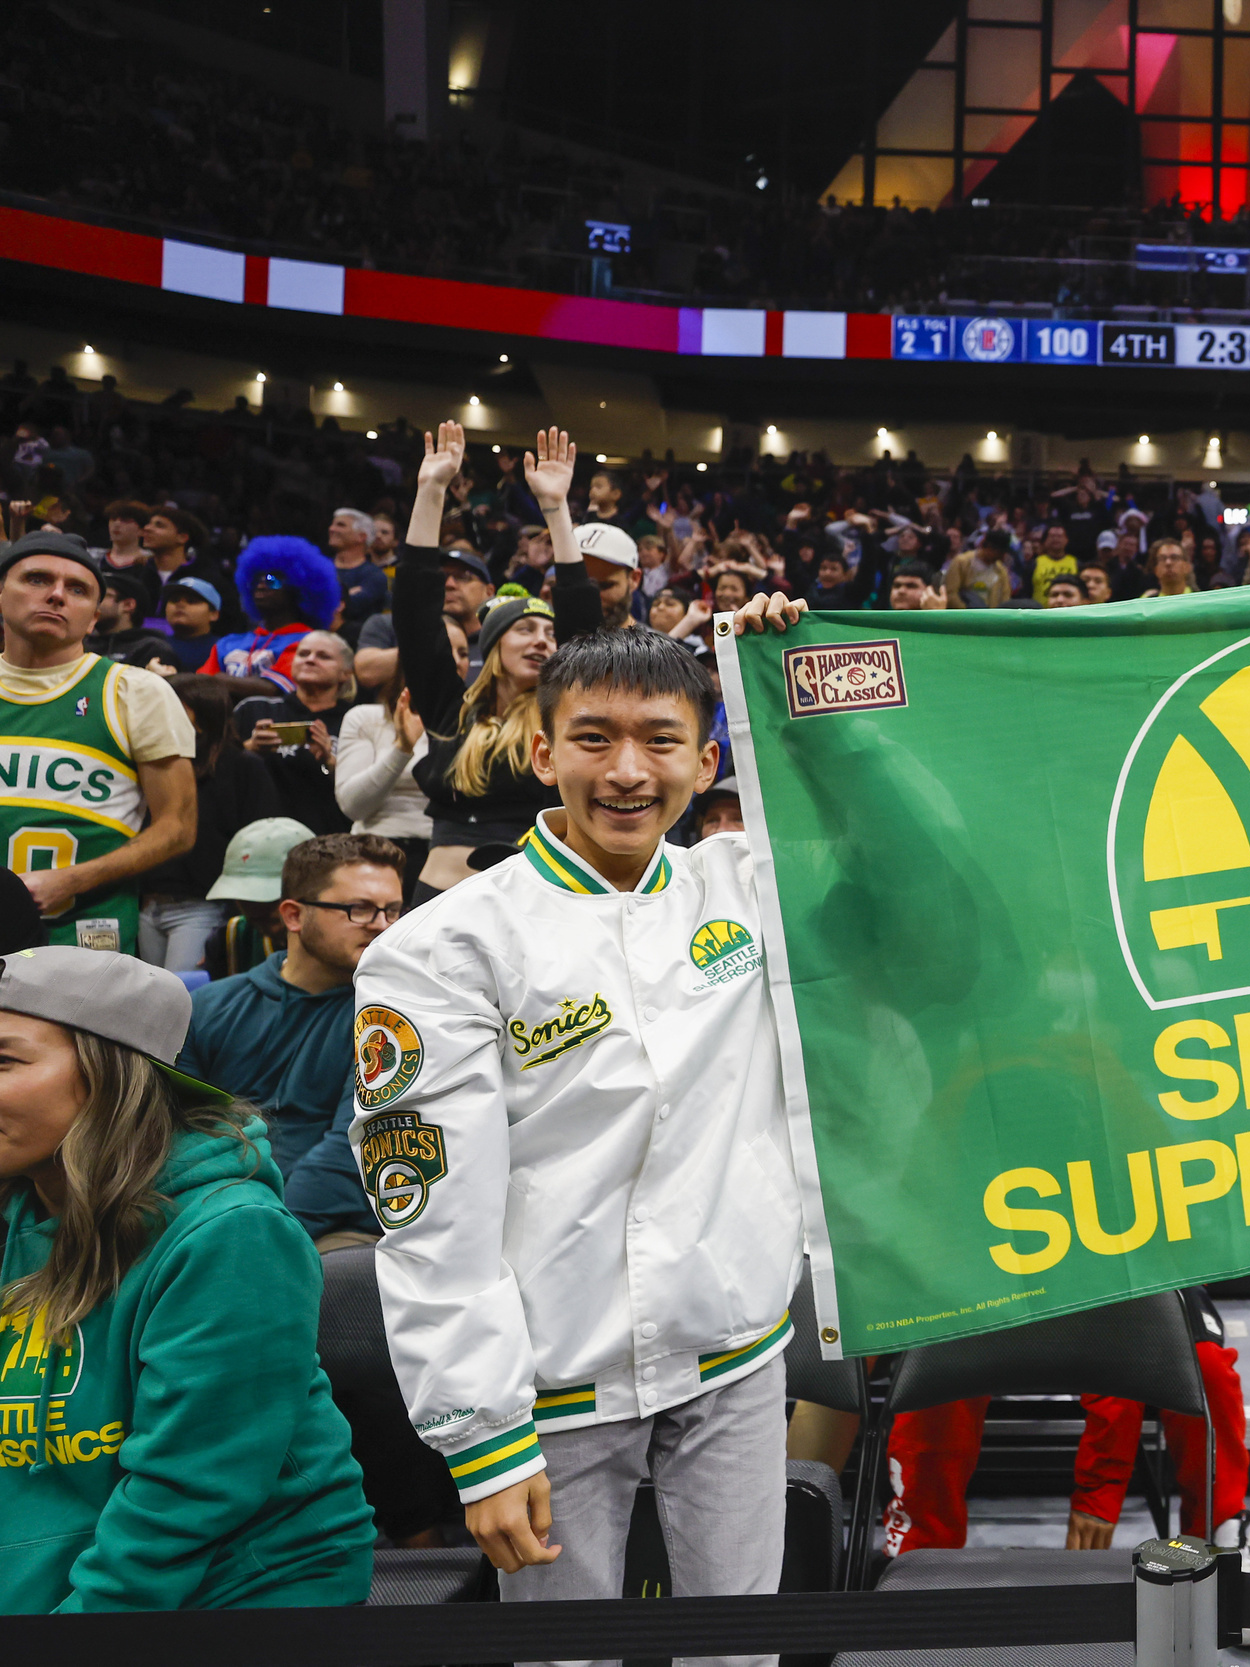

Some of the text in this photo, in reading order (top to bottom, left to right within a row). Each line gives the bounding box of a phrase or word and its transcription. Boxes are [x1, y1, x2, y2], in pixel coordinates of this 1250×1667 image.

[901, 331, 916, 354] 2
[931, 332, 942, 354] 1
[1037, 327, 1088, 357] 100
[1109, 334, 1167, 359] 4TH
[817, 650, 892, 682] HARDWOOD
[821, 676, 896, 704] CLASSICS
[693, 955, 763, 992] SUPERSON
[704, 945, 758, 980] SEATTLE
[355, 1010, 406, 1040] EATTLE
[509, 992, 613, 1057] Sonics
[366, 1116, 413, 1137] SEATTLE
[363, 1130, 437, 1174] SONICS
[876, 1320, 895, 1330] 2013
[896, 1317, 915, 1327] NBA
[976, 1301, 986, 1311] All
[987, 1297, 1011, 1308] Rights
[1011, 1286, 1047, 1301] Reserved.
